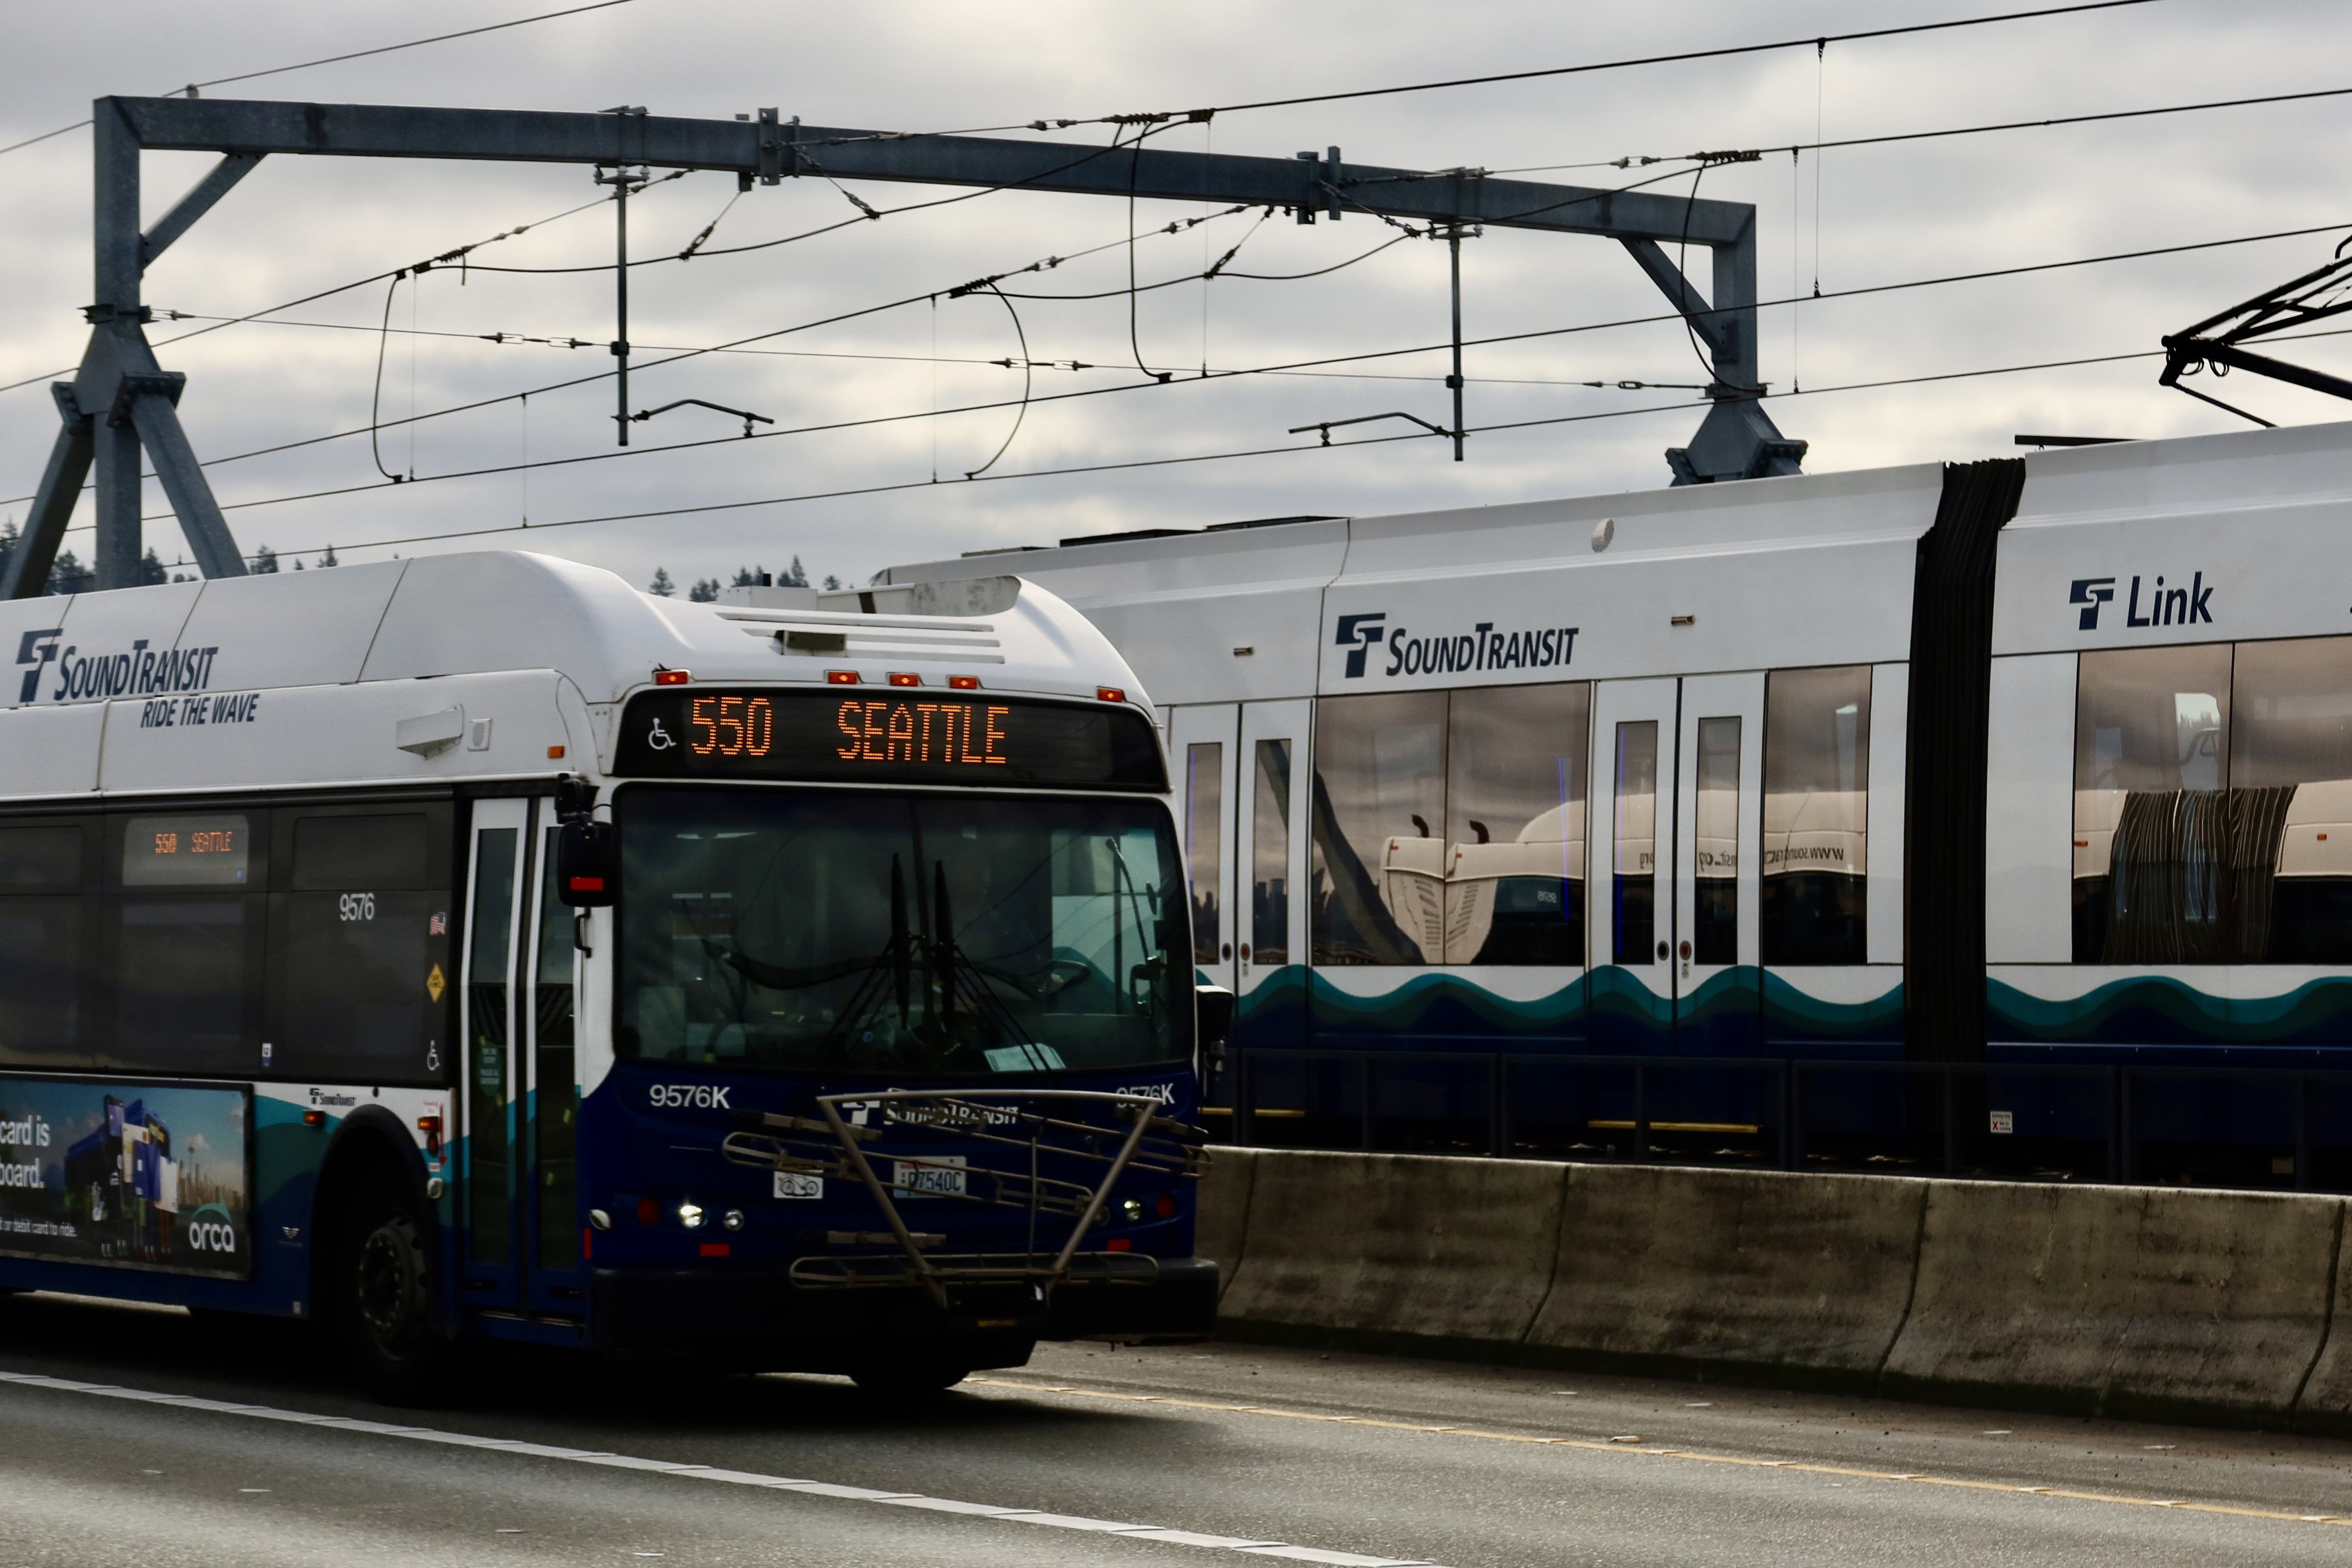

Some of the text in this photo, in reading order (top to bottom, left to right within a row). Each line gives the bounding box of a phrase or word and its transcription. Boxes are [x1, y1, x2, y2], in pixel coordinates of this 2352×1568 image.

[2127, 571, 2214, 628] Link
[1386, 622, 1579, 676] SOUNDTRANSIT
[54, 639, 219, 701] SOUNDTRANSIT
[140, 694, 259, 728] RIDE THE WAVE
[692, 697, 1009, 764] 550 SEATTLE
[155, 830, 233, 853] 550 SEATTLE
[340, 893, 375, 921] 9576
[649, 1084, 731, 1110] 9576K
[0, 1114, 51, 1147] card is
[189, 1222, 235, 1252] orca
